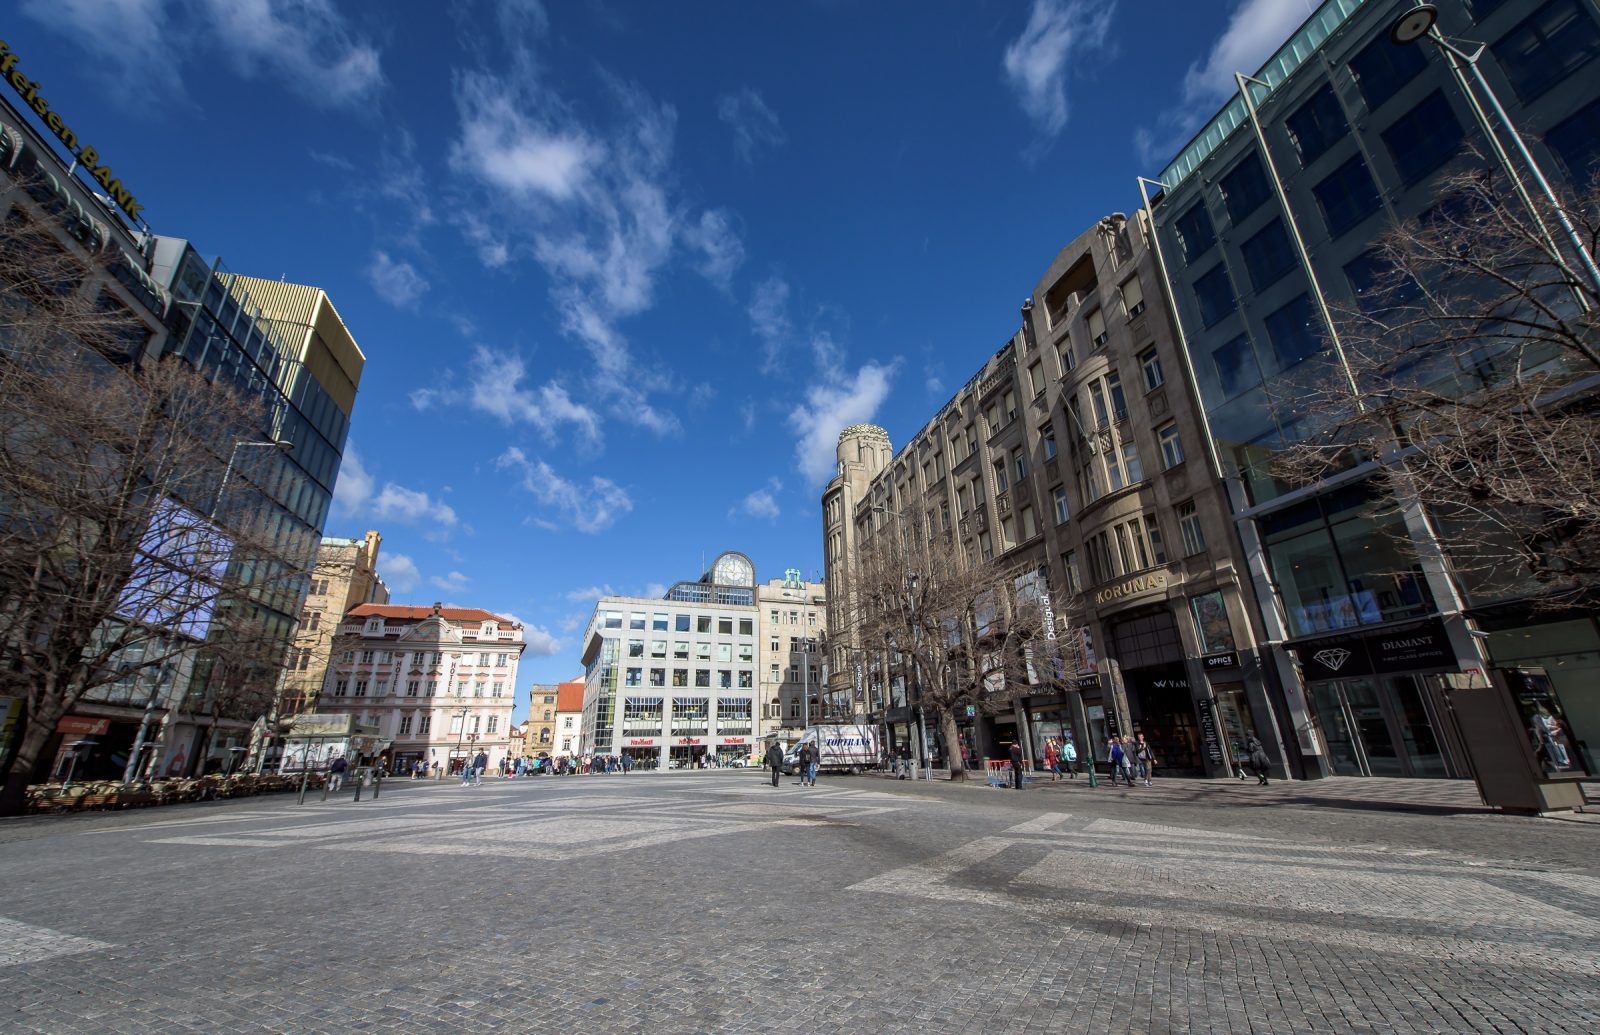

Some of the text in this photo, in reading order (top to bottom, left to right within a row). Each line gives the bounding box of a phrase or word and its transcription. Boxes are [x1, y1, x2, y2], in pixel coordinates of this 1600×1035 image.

[80, 144, 144, 221] BANK
[1096, 575, 1158, 604] KORUNA
[1382, 636, 1433, 650] DIAMANT
[1208, 656, 1232, 665] OFFICE
[392, 661, 402, 692] HOTEL
[447, 661, 456, 692] HOTEL
[826, 738, 872, 747] TOPTRANS
